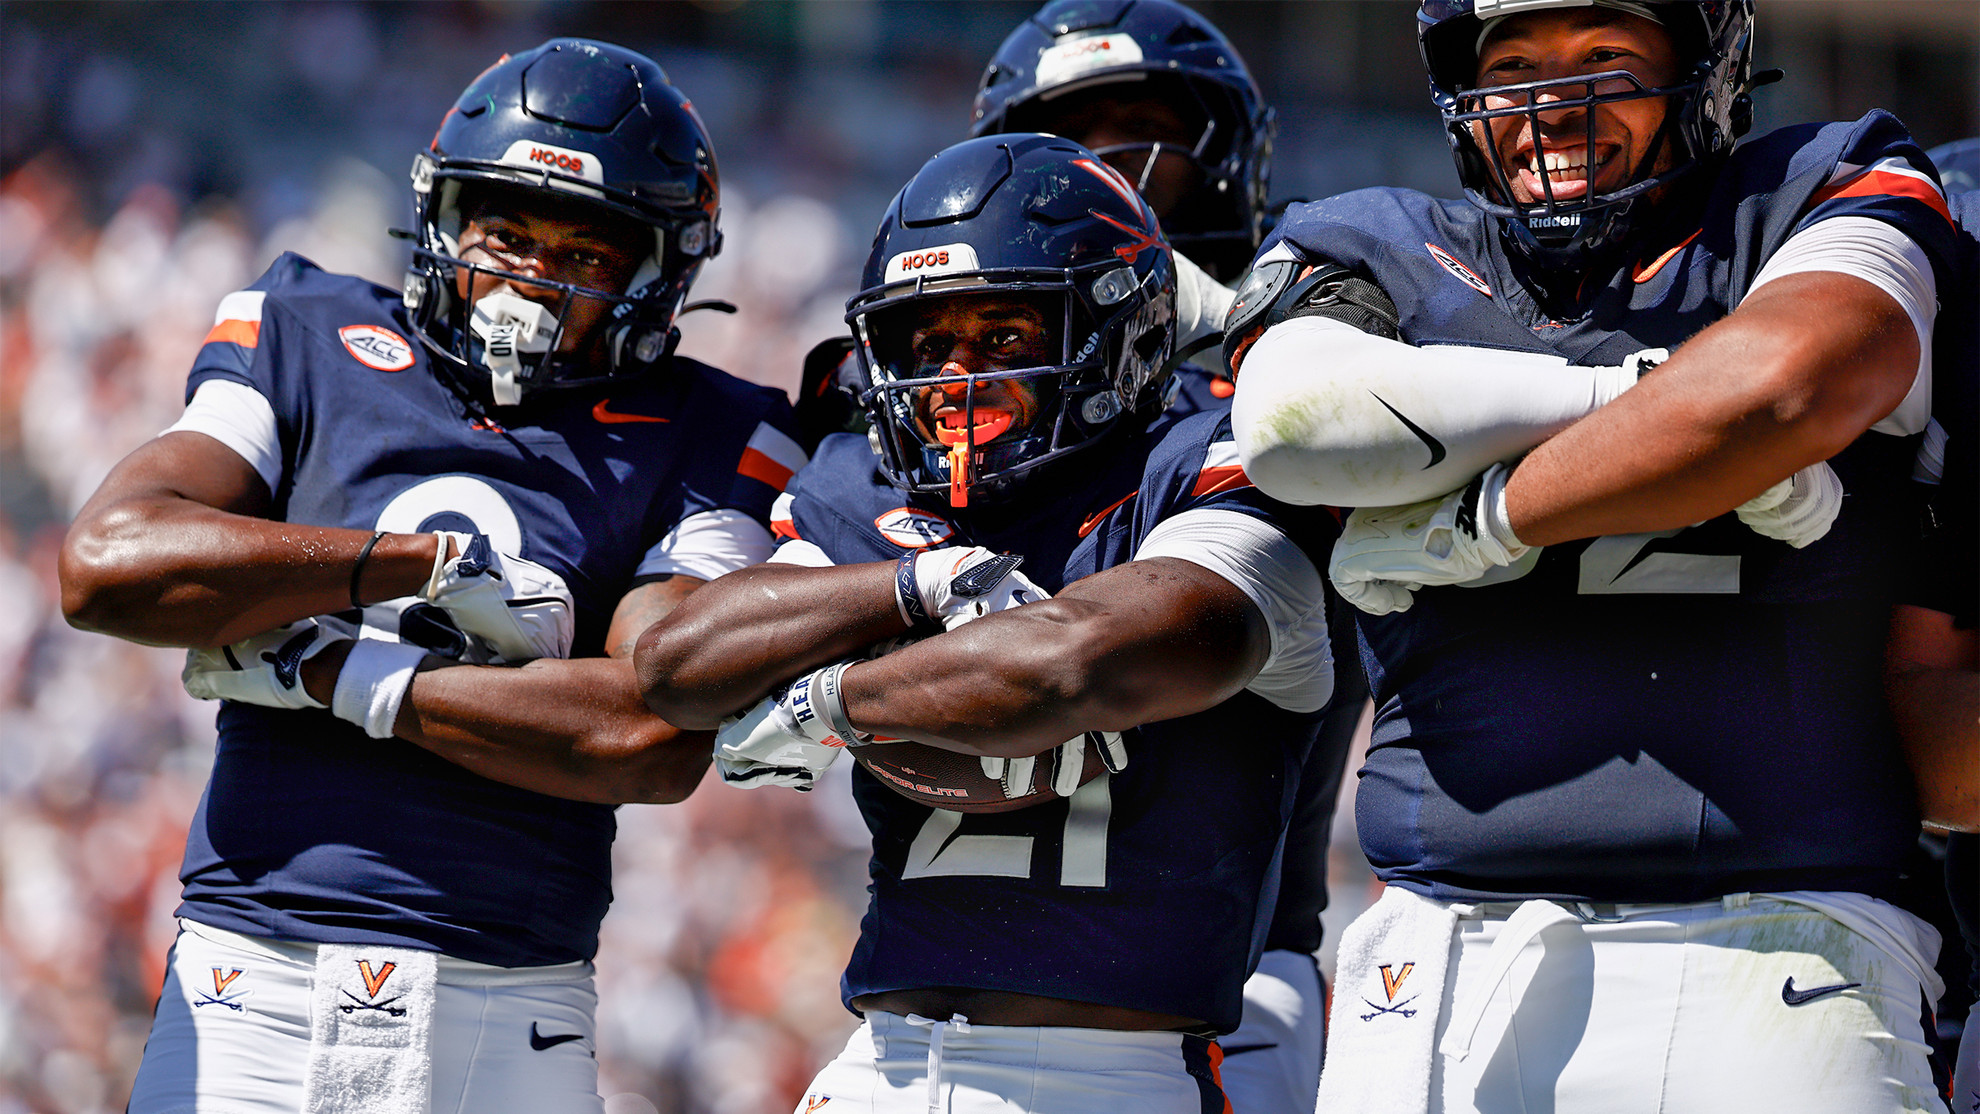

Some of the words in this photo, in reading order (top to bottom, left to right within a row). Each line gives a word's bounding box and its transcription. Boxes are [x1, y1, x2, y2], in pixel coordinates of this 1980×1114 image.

[529, 147, 583, 172] HOOS
[1528, 213, 1581, 229] Riddell
[902, 250, 949, 271] HOOS
[1436, 253, 1487, 289] ACC
[347, 336, 406, 363] ACC
[1075, 331, 1100, 364] dell
[881, 517, 946, 538] ACC
[866, 758, 916, 791] VAPOR
[915, 784, 969, 797] ELITE
[901, 768, 1111, 888] 21
